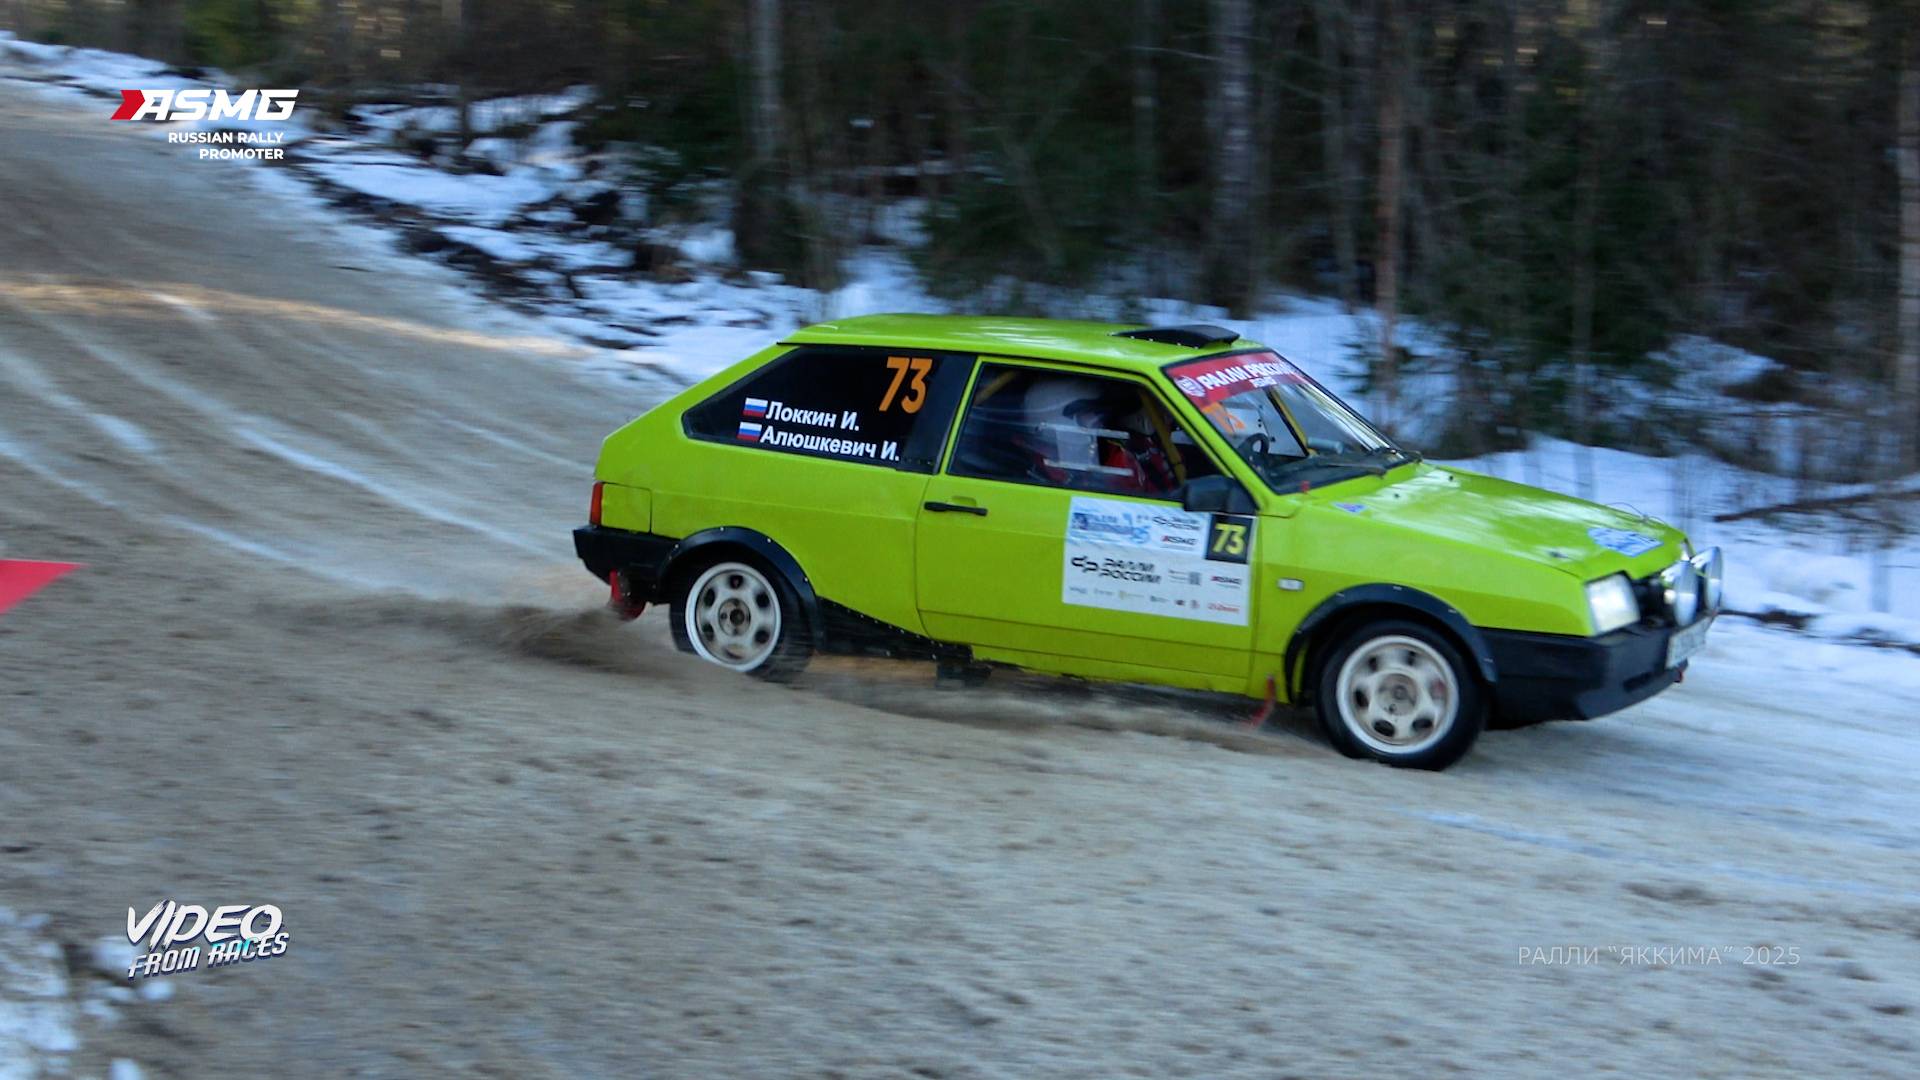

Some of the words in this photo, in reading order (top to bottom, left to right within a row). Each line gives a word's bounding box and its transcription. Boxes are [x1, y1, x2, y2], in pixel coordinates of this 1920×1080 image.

[878, 356, 934, 414] 73
[765, 401, 837, 429] Локкин
[839, 410, 861, 432] И.
[759, 425, 877, 458] Алюшкевич
[880, 440, 901, 462] И.
[1211, 522, 1248, 556] 73
